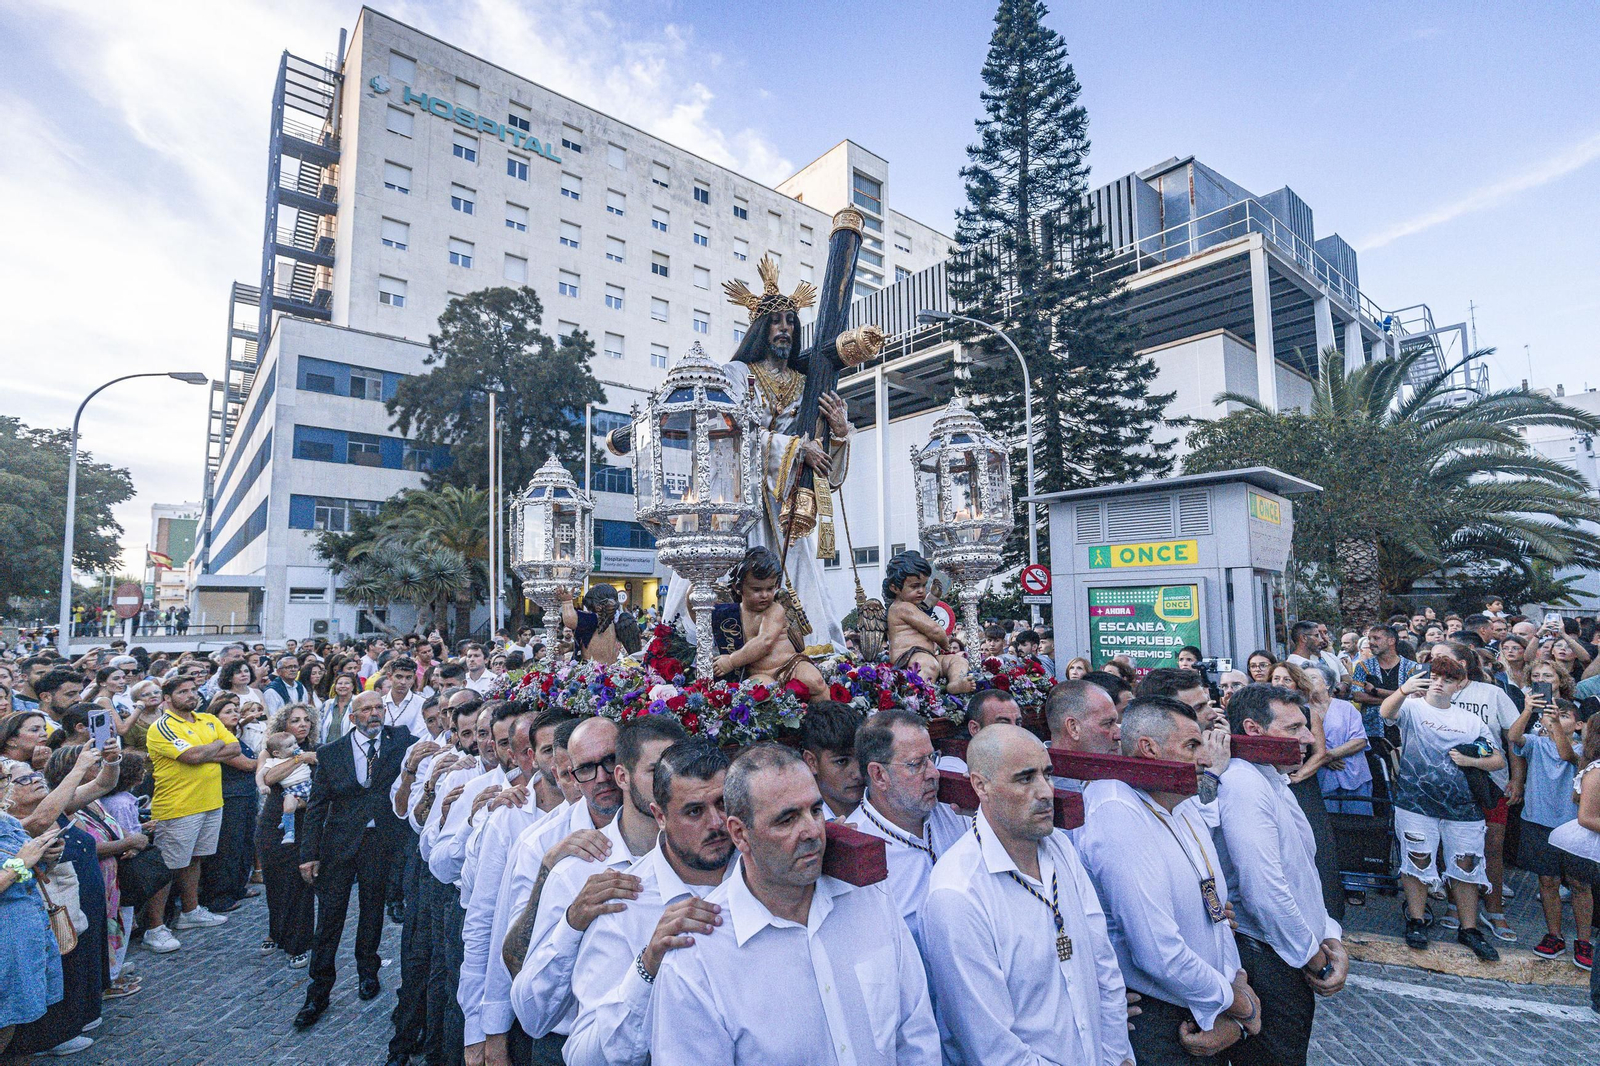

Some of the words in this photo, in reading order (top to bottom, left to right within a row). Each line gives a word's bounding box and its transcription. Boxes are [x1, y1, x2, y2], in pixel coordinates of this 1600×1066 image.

[403, 85, 562, 163] HOSPITAL
[1259, 499, 1279, 521] ONCE
[1119, 544, 1189, 563] ONCE
[1105, 607, 1131, 615] AHORA
[1098, 622, 1166, 632] ESCANEA
[1170, 623, 1178, 632] Y
[1099, 635, 1185, 646] COMPRUEBA
